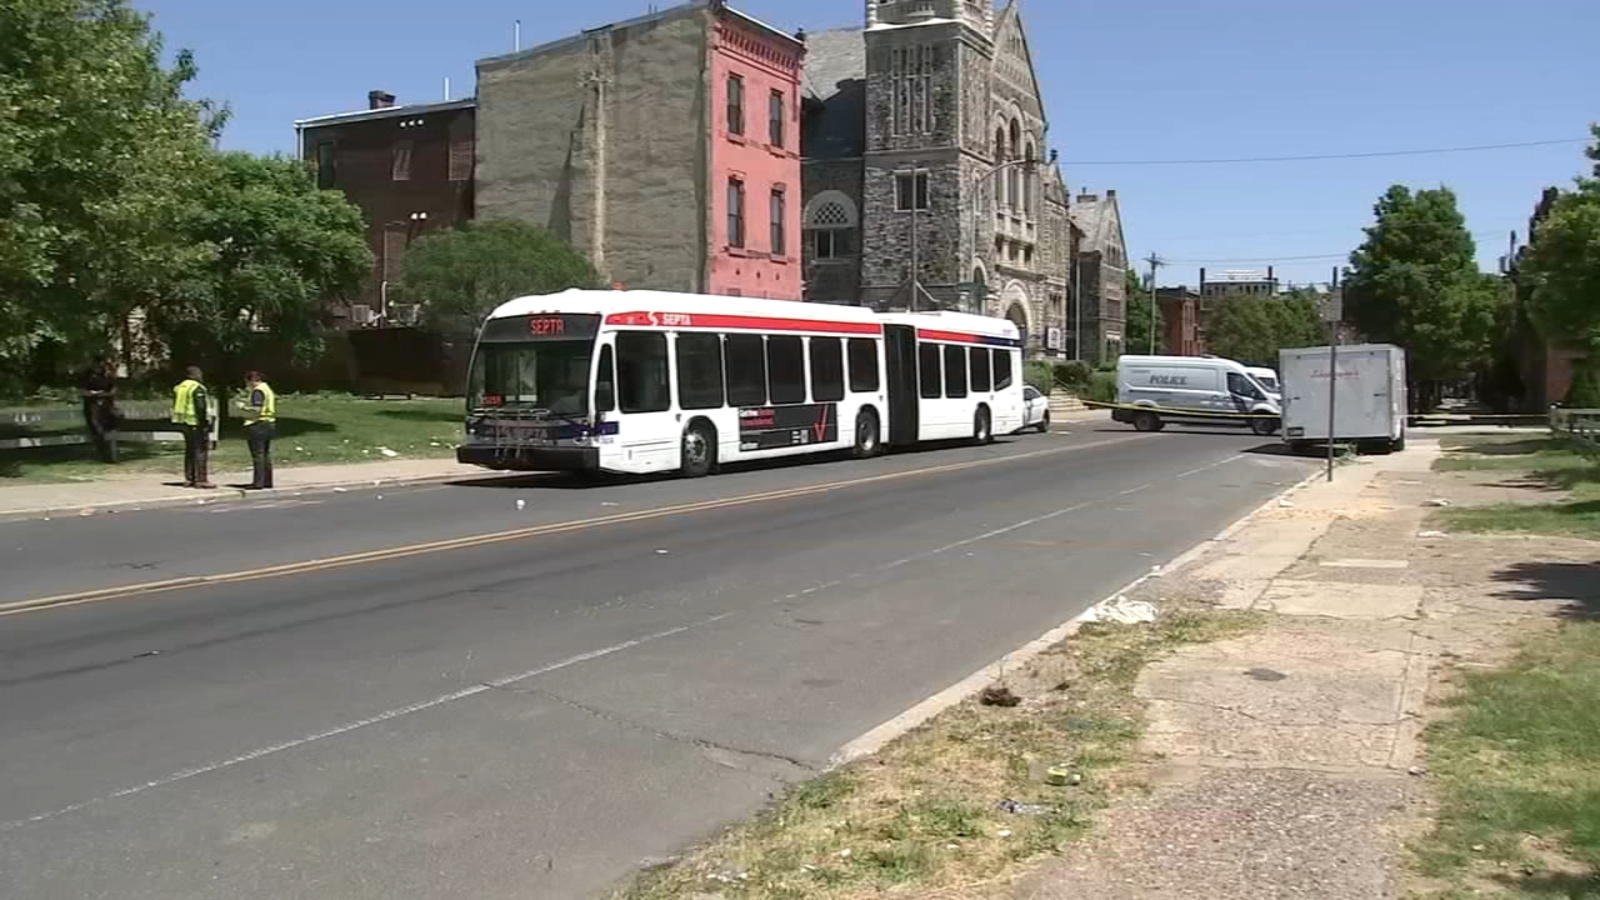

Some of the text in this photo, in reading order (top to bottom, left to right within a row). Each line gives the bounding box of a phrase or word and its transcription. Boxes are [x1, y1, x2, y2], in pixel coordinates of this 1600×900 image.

[661, 313, 692, 326] SEPTA
[530, 319, 564, 334] SEPTA
[1149, 374, 1188, 386] POLICE
